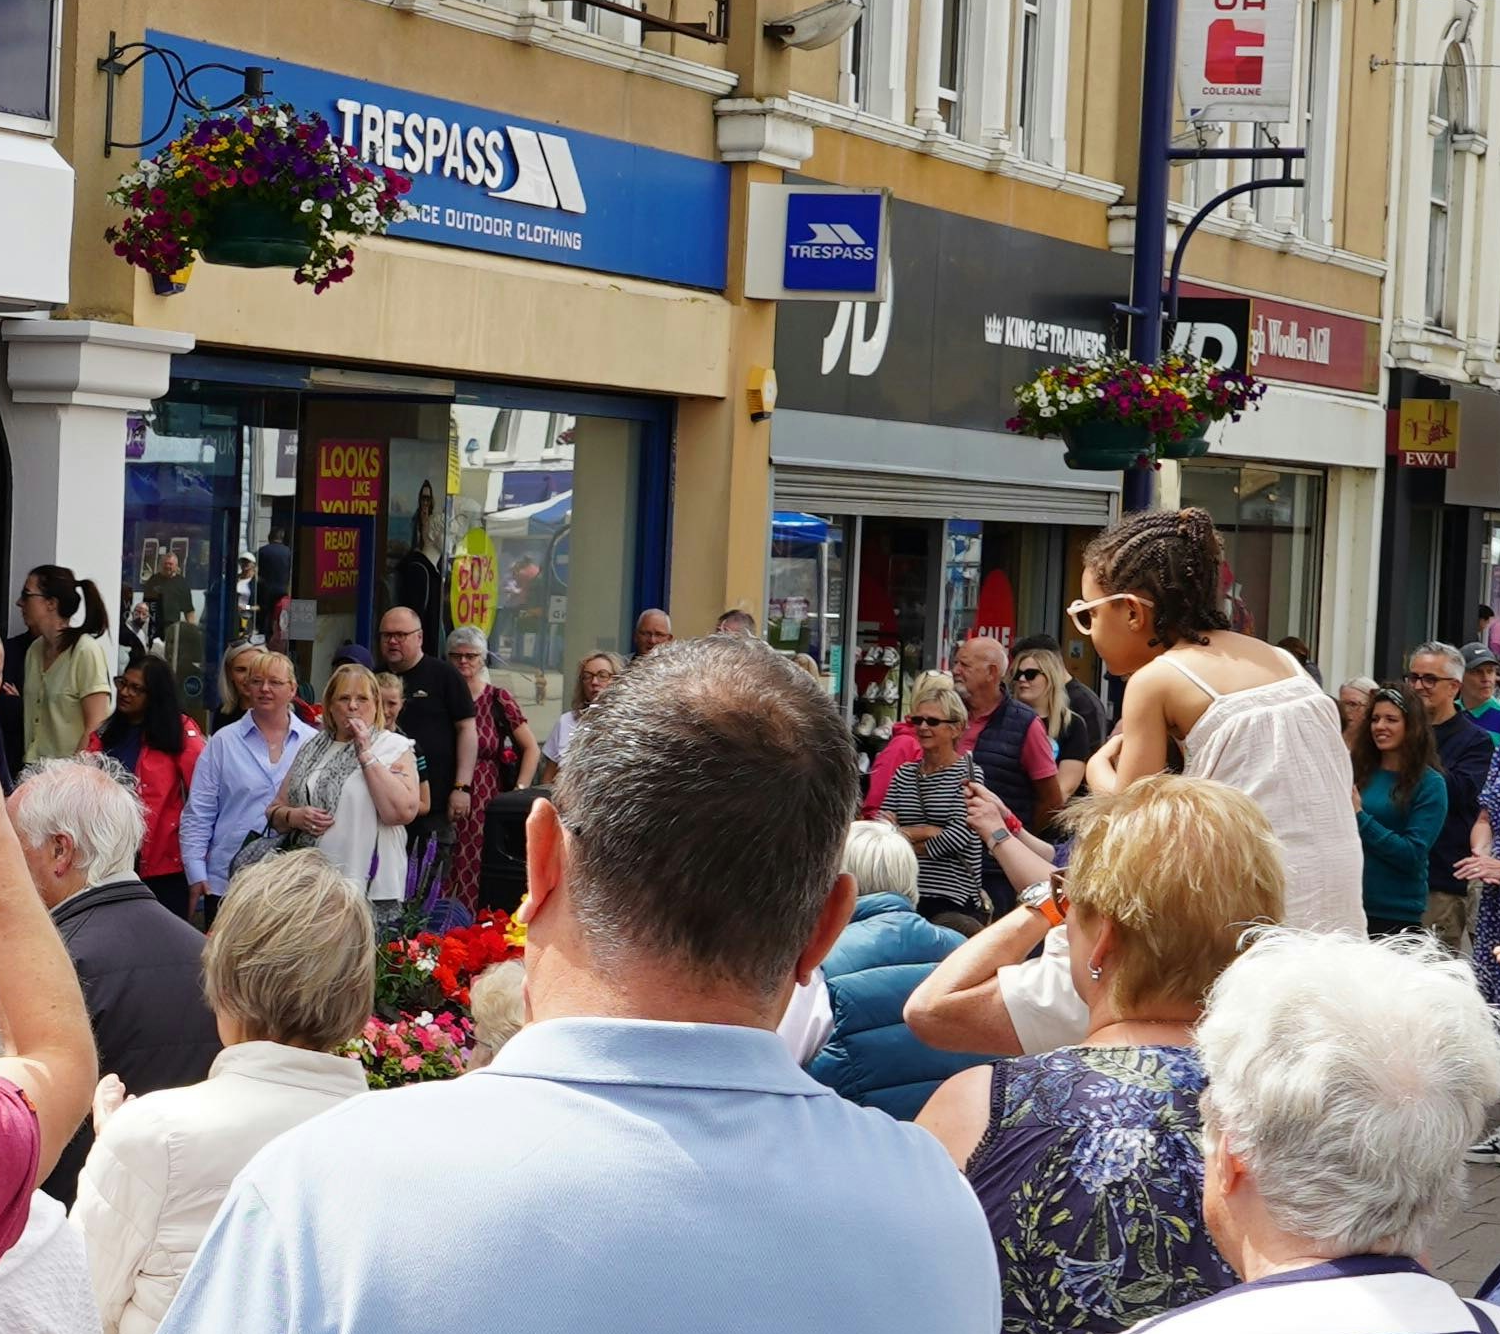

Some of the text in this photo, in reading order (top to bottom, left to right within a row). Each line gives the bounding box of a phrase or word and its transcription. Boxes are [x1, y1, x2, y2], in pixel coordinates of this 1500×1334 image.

[1202, 86, 1262, 97] COLERAINE
[337, 98, 505, 189] TRESPASS
[446, 208, 512, 238] OUTDOOR
[517, 222, 583, 251] CLOTHING
[788, 245, 875, 261] TRESPASS
[1005, 316, 1107, 360] KING OF TRAINERS
[1266, 319, 1308, 361] Woollen
[1308, 327, 1331, 365] Mill
[320, 445, 380, 478] LOOKS
[1405, 451, 1449, 467] EWM
[352, 480, 370, 497] LIKE
[324, 531, 358, 550] READY
[338, 551, 355, 567] FOR
[457, 593, 489, 624] OFF
